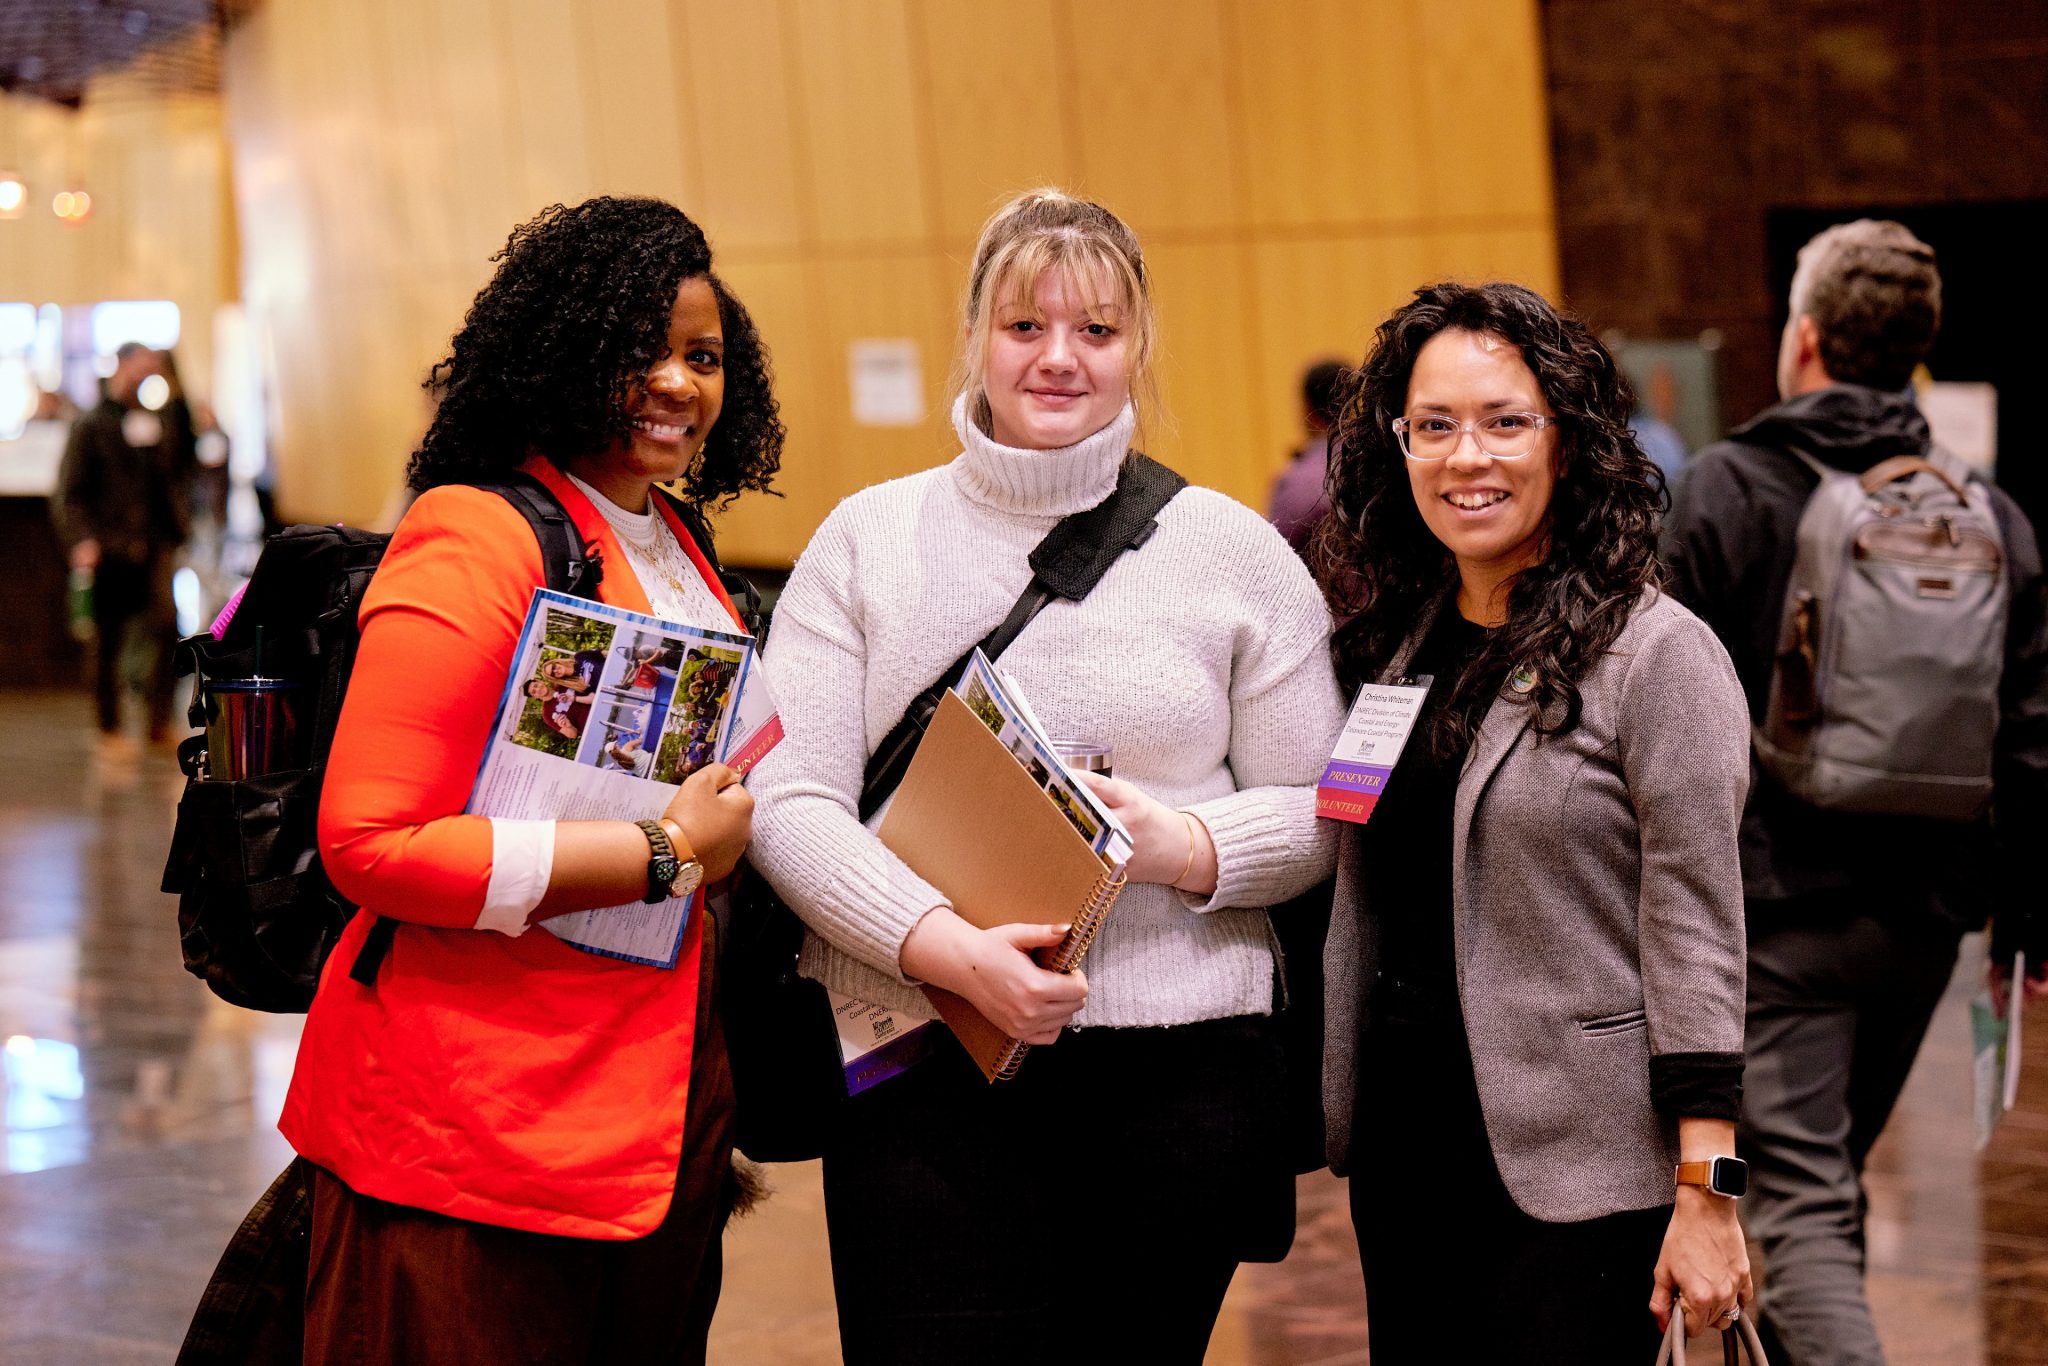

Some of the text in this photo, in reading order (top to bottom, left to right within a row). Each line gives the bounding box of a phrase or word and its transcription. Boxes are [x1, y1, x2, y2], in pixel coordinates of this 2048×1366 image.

[1364, 692, 1388, 702] Christina
[736, 733, 776, 774] UNTEER
[1327, 770, 1381, 787] PRESENTER
[835, 998, 858, 1015] DNREC
